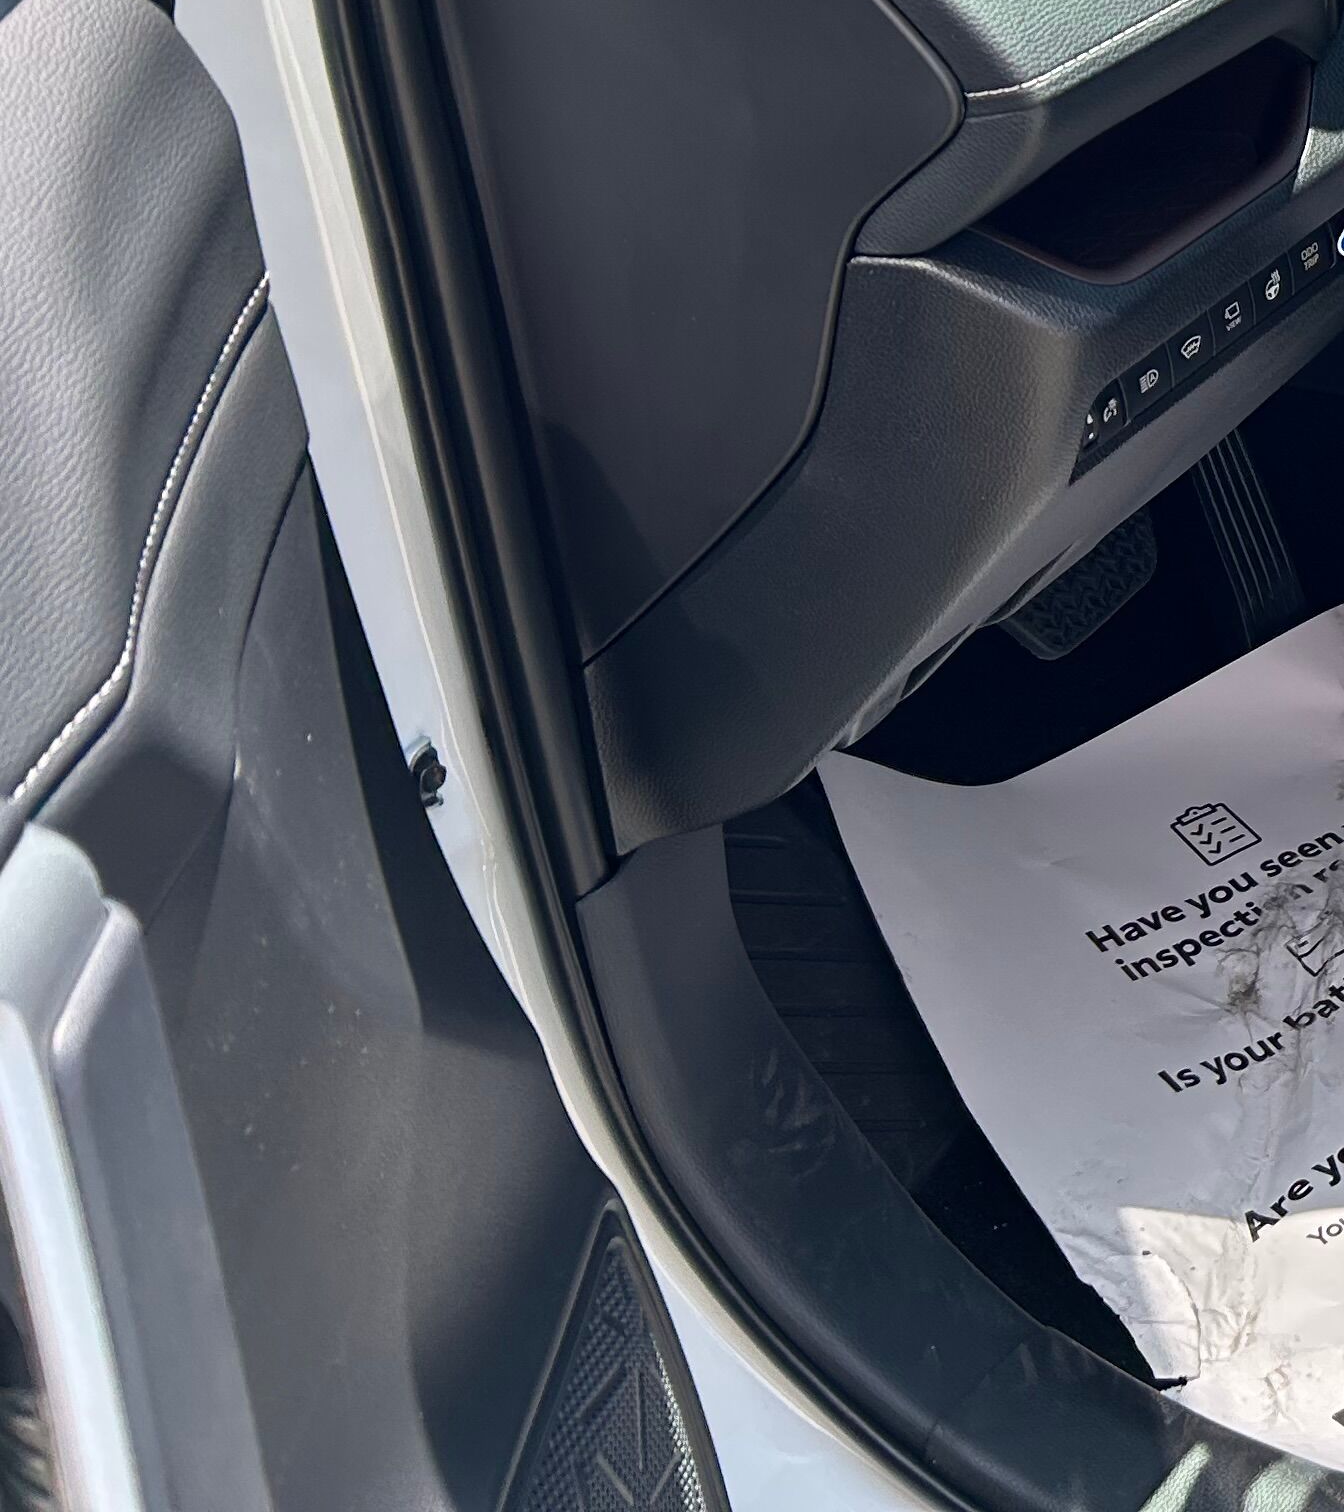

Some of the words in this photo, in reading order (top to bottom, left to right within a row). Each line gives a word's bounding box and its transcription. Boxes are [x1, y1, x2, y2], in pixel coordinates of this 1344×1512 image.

[1083, 899, 1187, 955] Have
[1184, 869, 1258, 922] you
[1258, 826, 1344, 880] seen
[1113, 876, 1314, 986] inspectin
[1157, 1063, 1201, 1096] Is
[1198, 1029, 1289, 1086] your
[1237, 1172, 1315, 1244] Are
